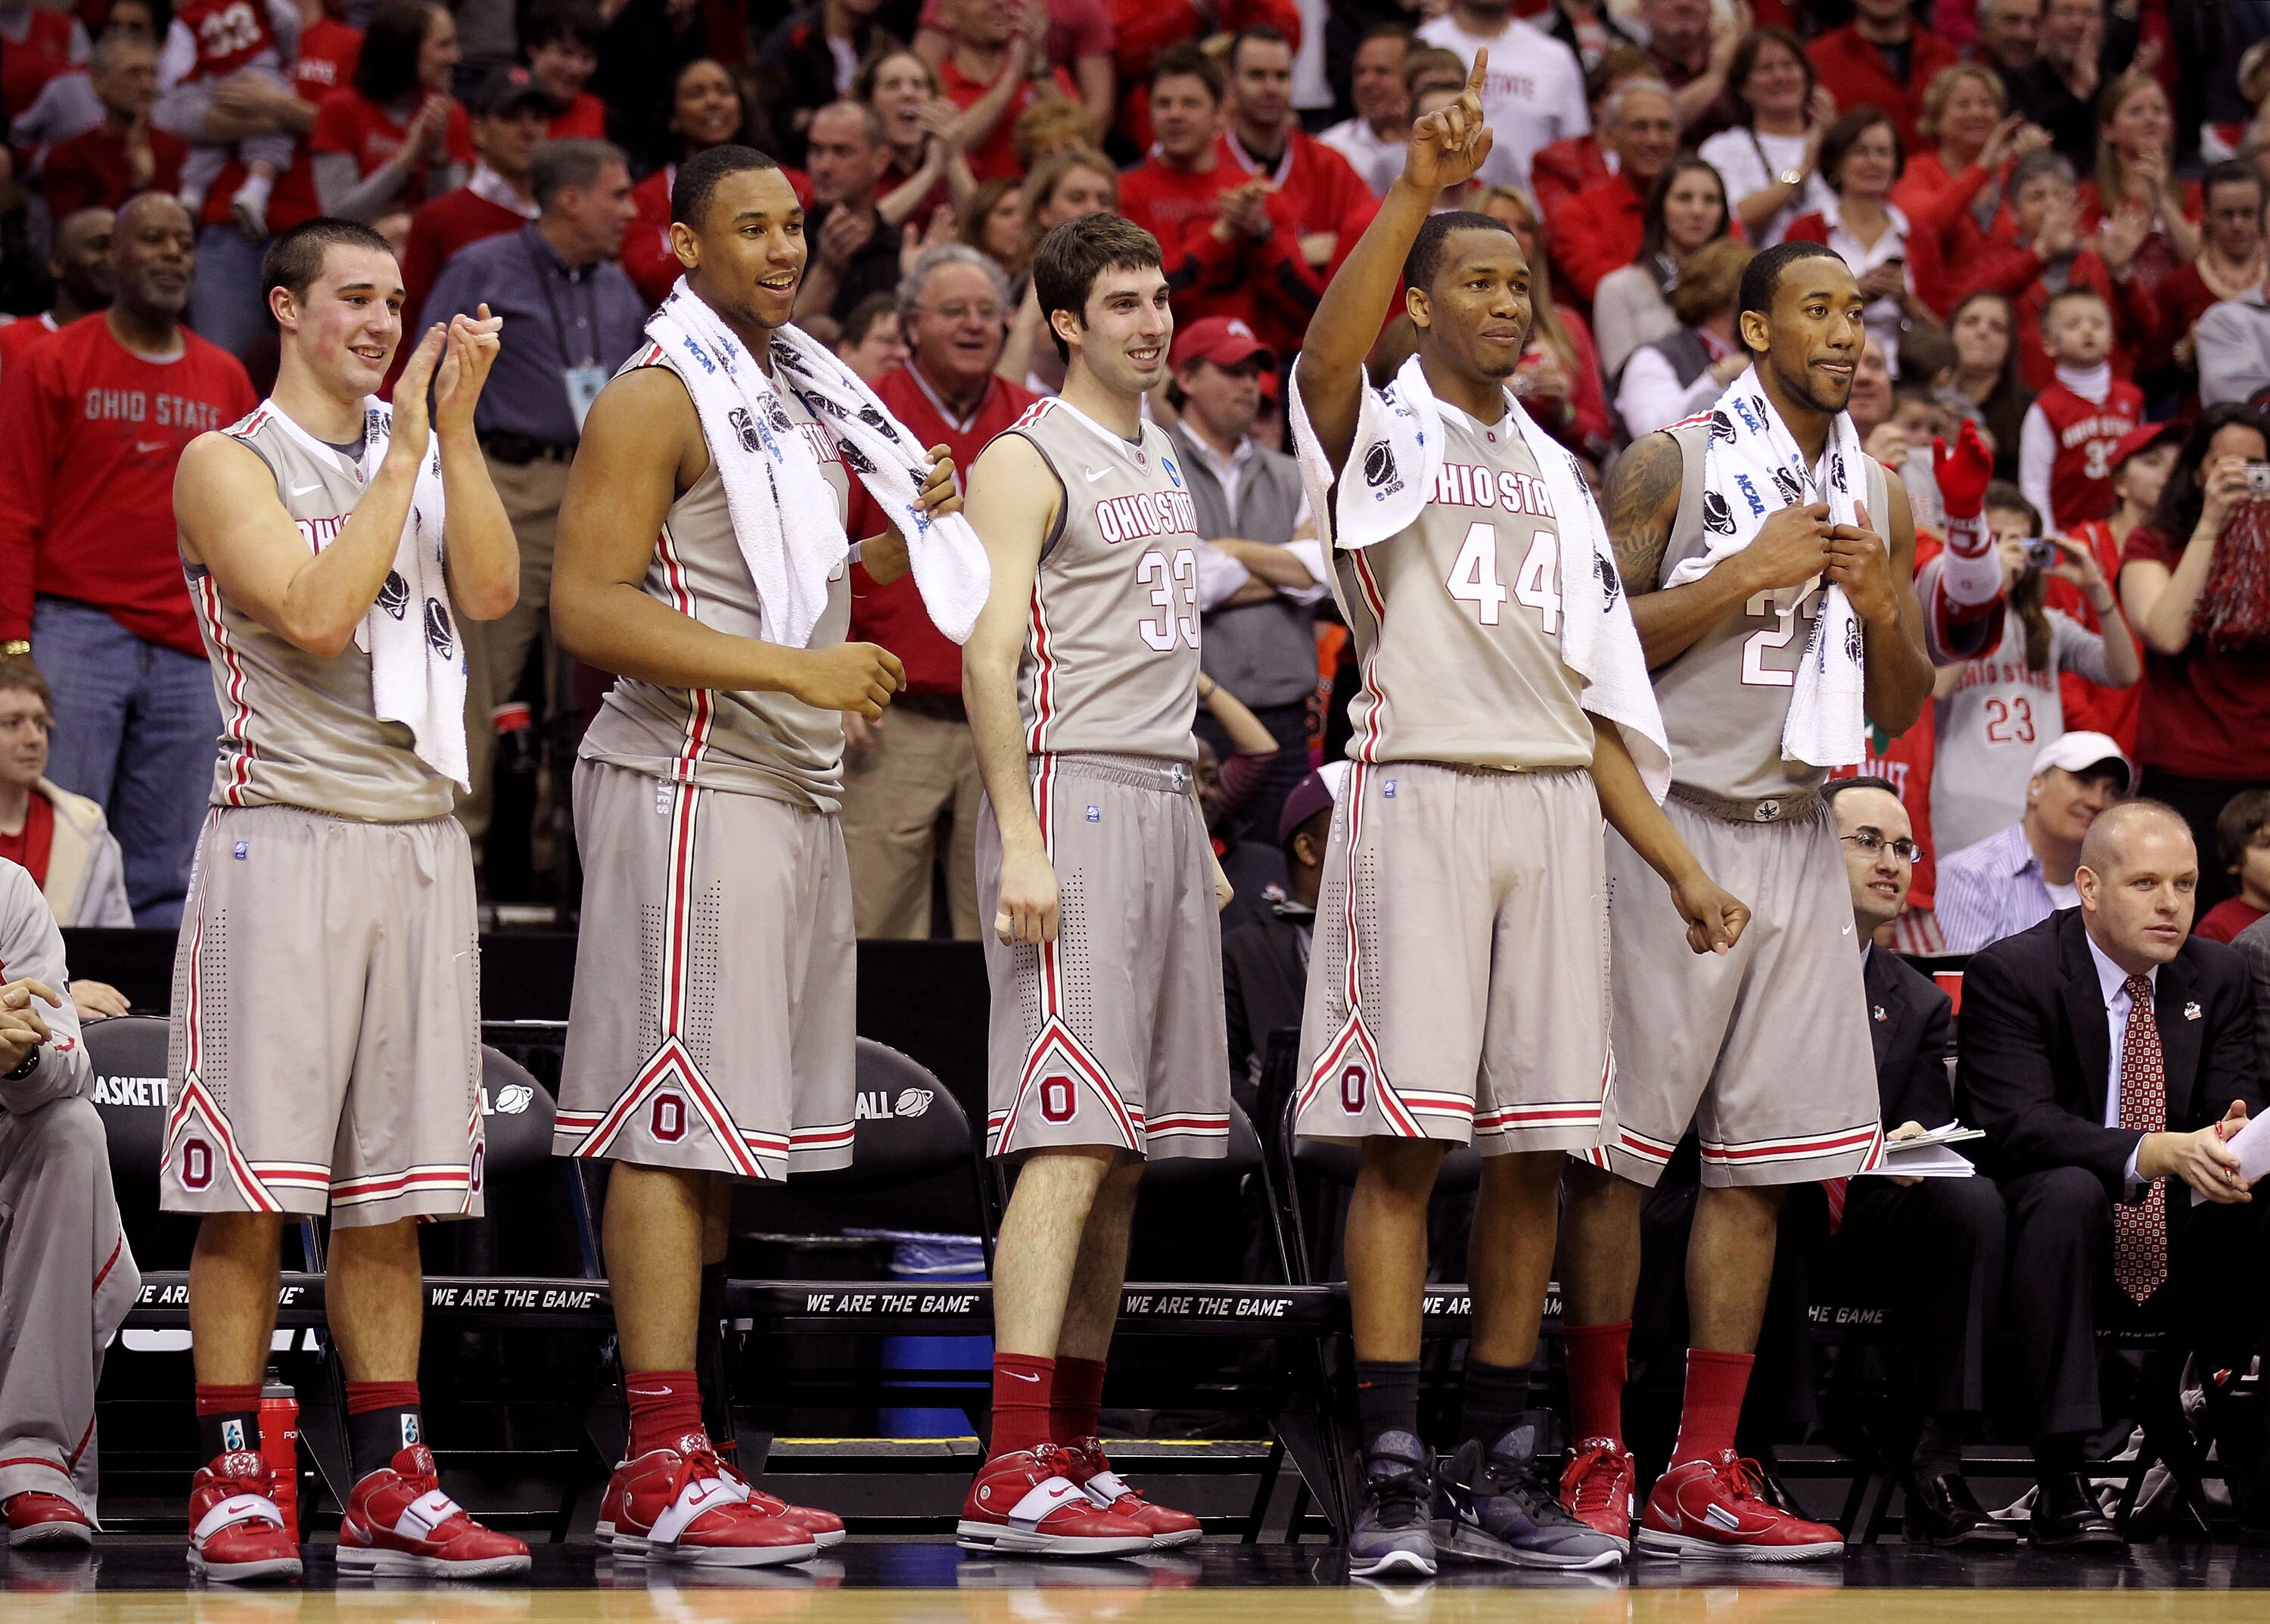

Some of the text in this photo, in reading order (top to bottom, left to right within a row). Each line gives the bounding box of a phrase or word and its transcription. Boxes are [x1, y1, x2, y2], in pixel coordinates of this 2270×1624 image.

[86, 387, 219, 431] OHIO STATE
[1427, 462, 1497, 509] HIO
[1734, 474, 1766, 519] NCAA
[1095, 493, 1161, 545] OHIO
[1136, 548, 1200, 652] 33
[1445, 521, 1563, 636] 44
[1984, 695, 2035, 745] 23
[91, 1075, 168, 1106] ASKET
[431, 1288, 458, 1306] WE
[460, 1289, 499, 1307] ARE
[504, 1290, 539, 1308] THE
[807, 1294, 835, 1311] WE
[836, 1295, 876, 1312] ARE
[881, 1295, 917, 1312] THE
[1126, 1296, 1152, 1313] WE
[1155, 1296, 1193, 1314] ARE
[1197, 1297, 1233, 1315] THE
[1808, 1305, 1832, 1323] HE
